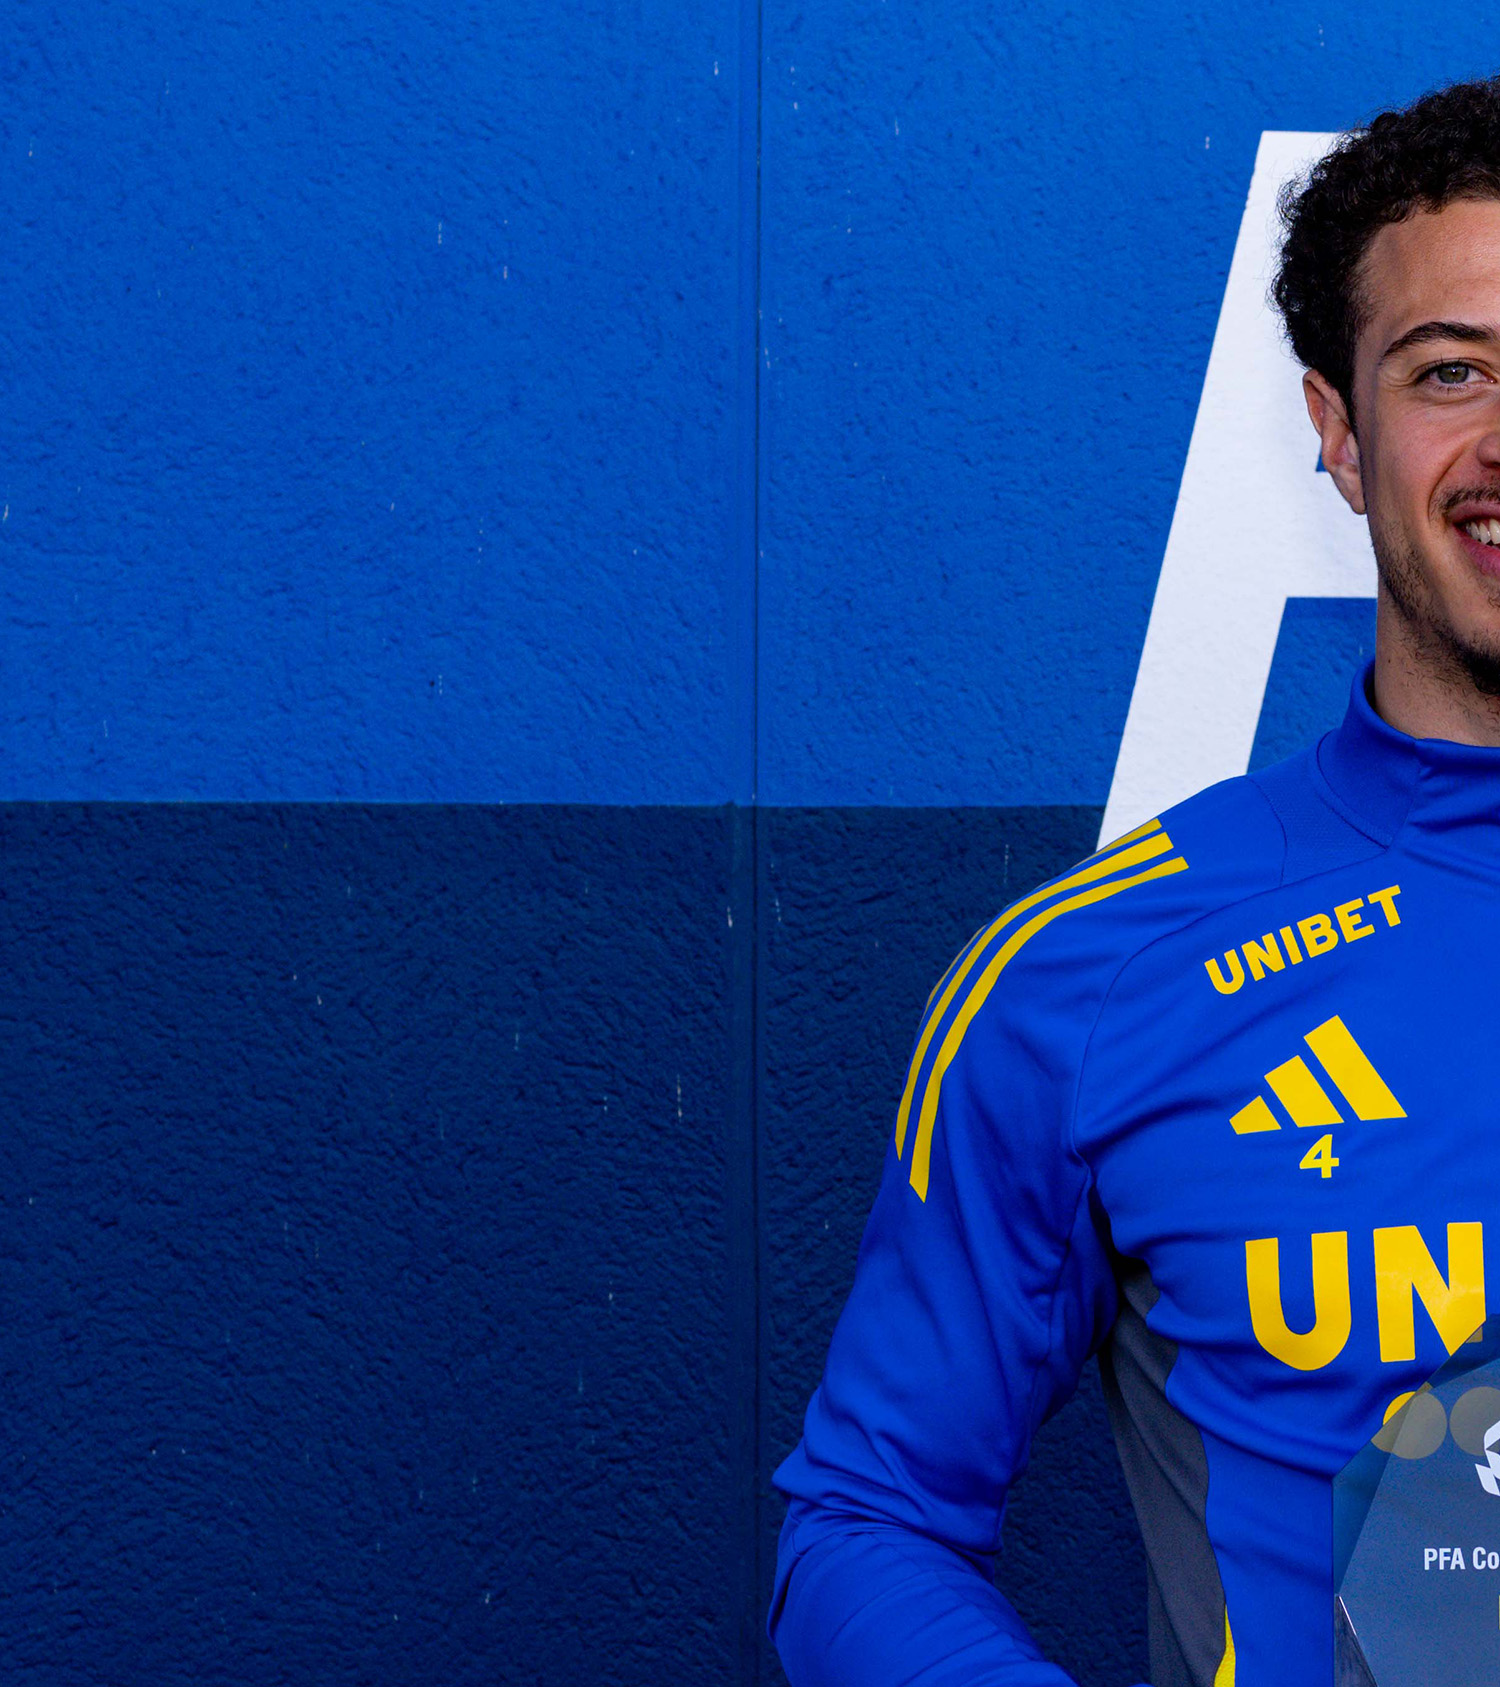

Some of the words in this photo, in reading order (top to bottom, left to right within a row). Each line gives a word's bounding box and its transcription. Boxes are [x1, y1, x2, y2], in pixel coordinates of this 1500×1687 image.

[1204, 884, 1401, 995] UNIBET
[1299, 1134, 1340, 1179] 4
[1424, 1547, 1466, 1571] PFA
